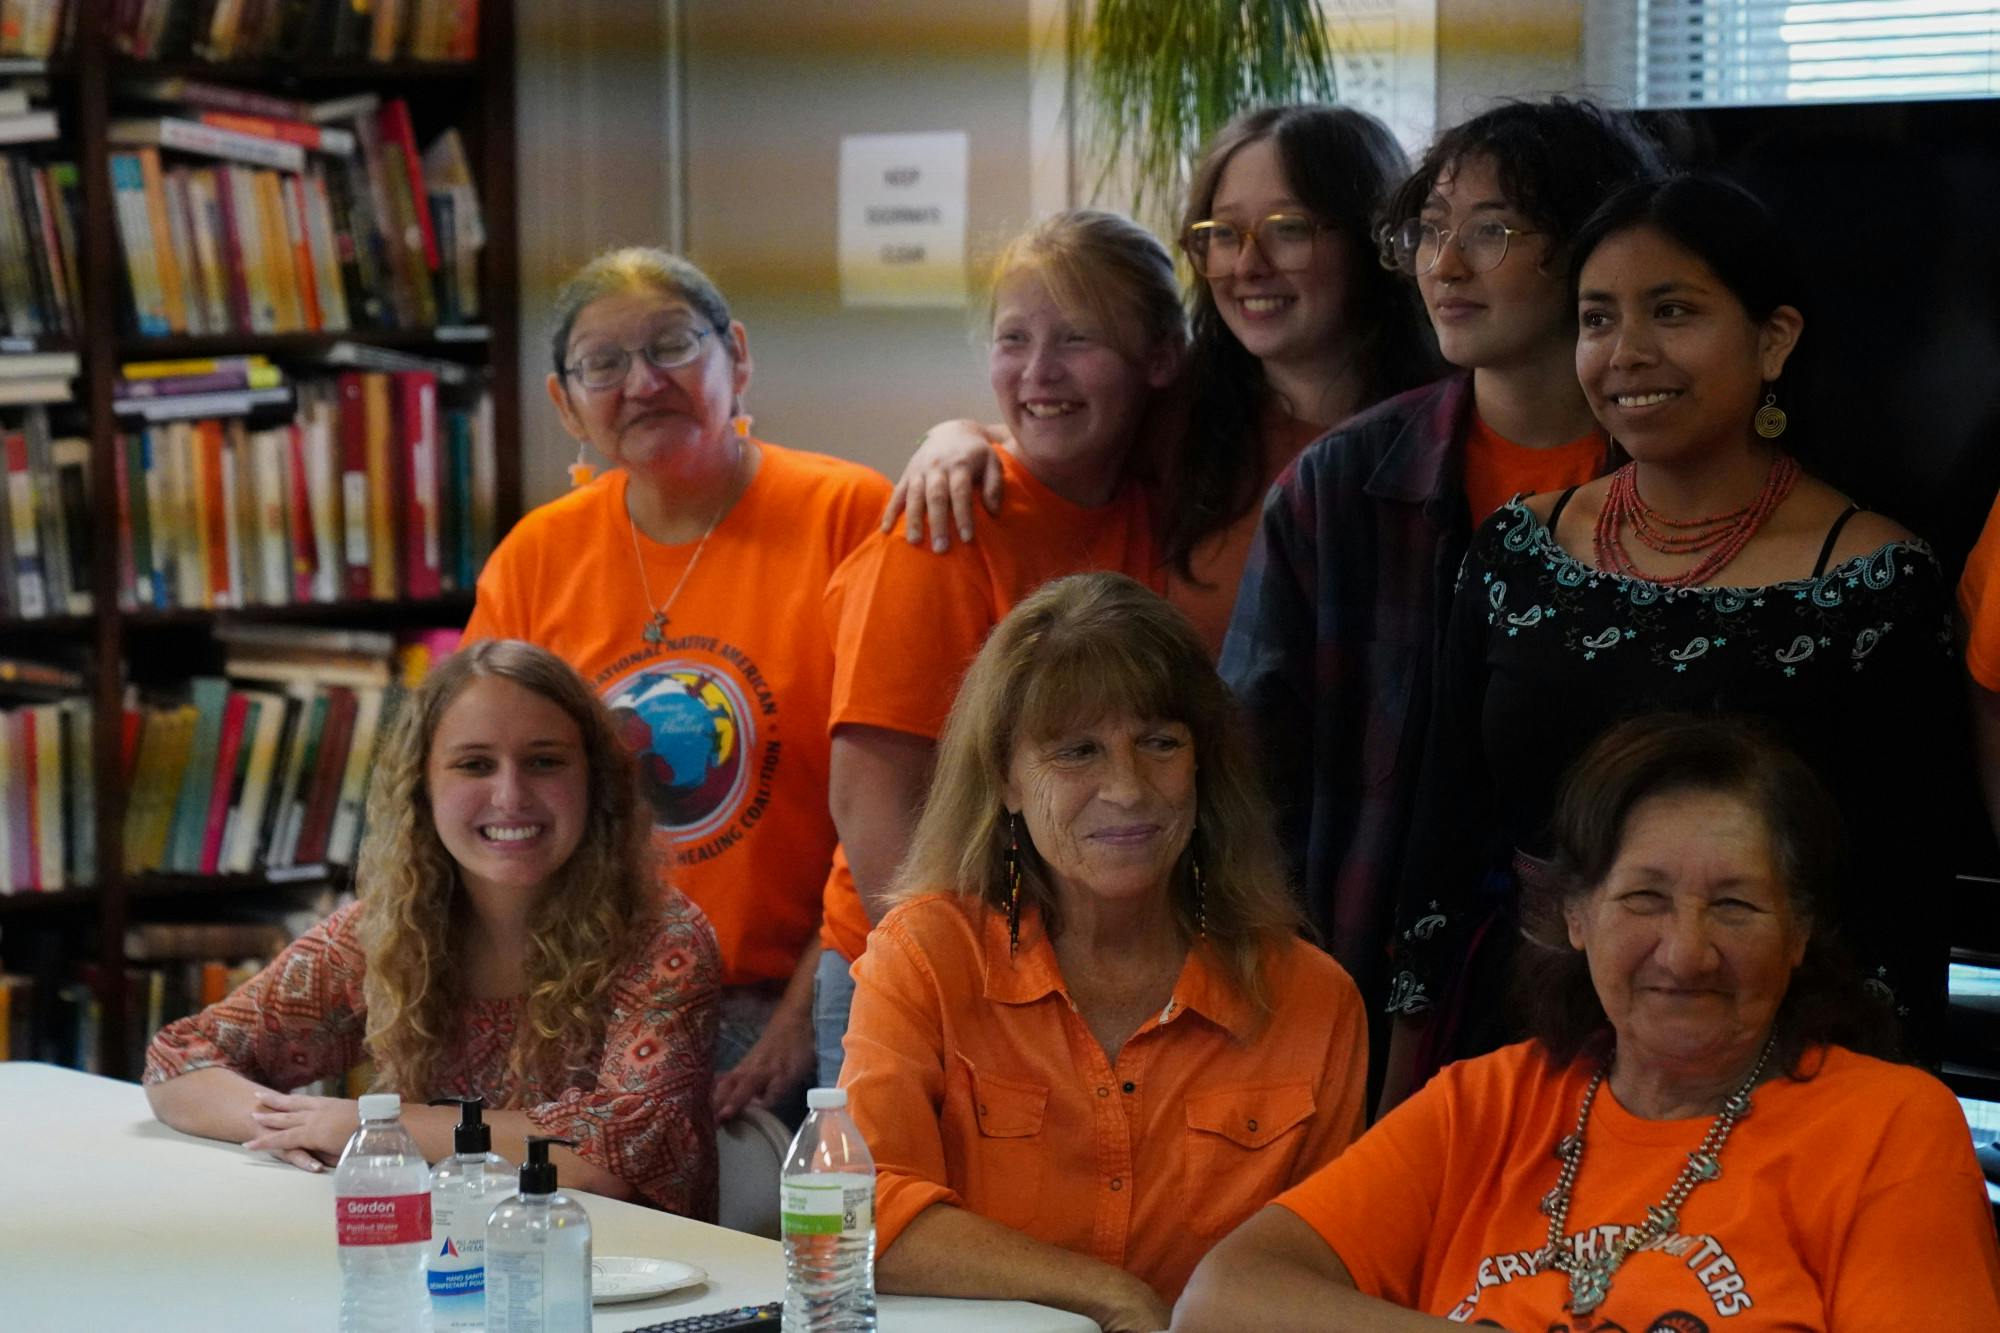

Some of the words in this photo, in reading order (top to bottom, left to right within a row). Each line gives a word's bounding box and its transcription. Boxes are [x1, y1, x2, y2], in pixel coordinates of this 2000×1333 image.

[592, 646, 661, 689] ATIONAL
[667, 635, 720, 652] NATIVE
[721, 643, 777, 716] AMERICAN
[677, 825, 743, 865] HEALING
[740, 740, 782, 829] COALITION
[347, 1200, 395, 1214] Gordon
[465, 1272, 484, 1281] SANIT
